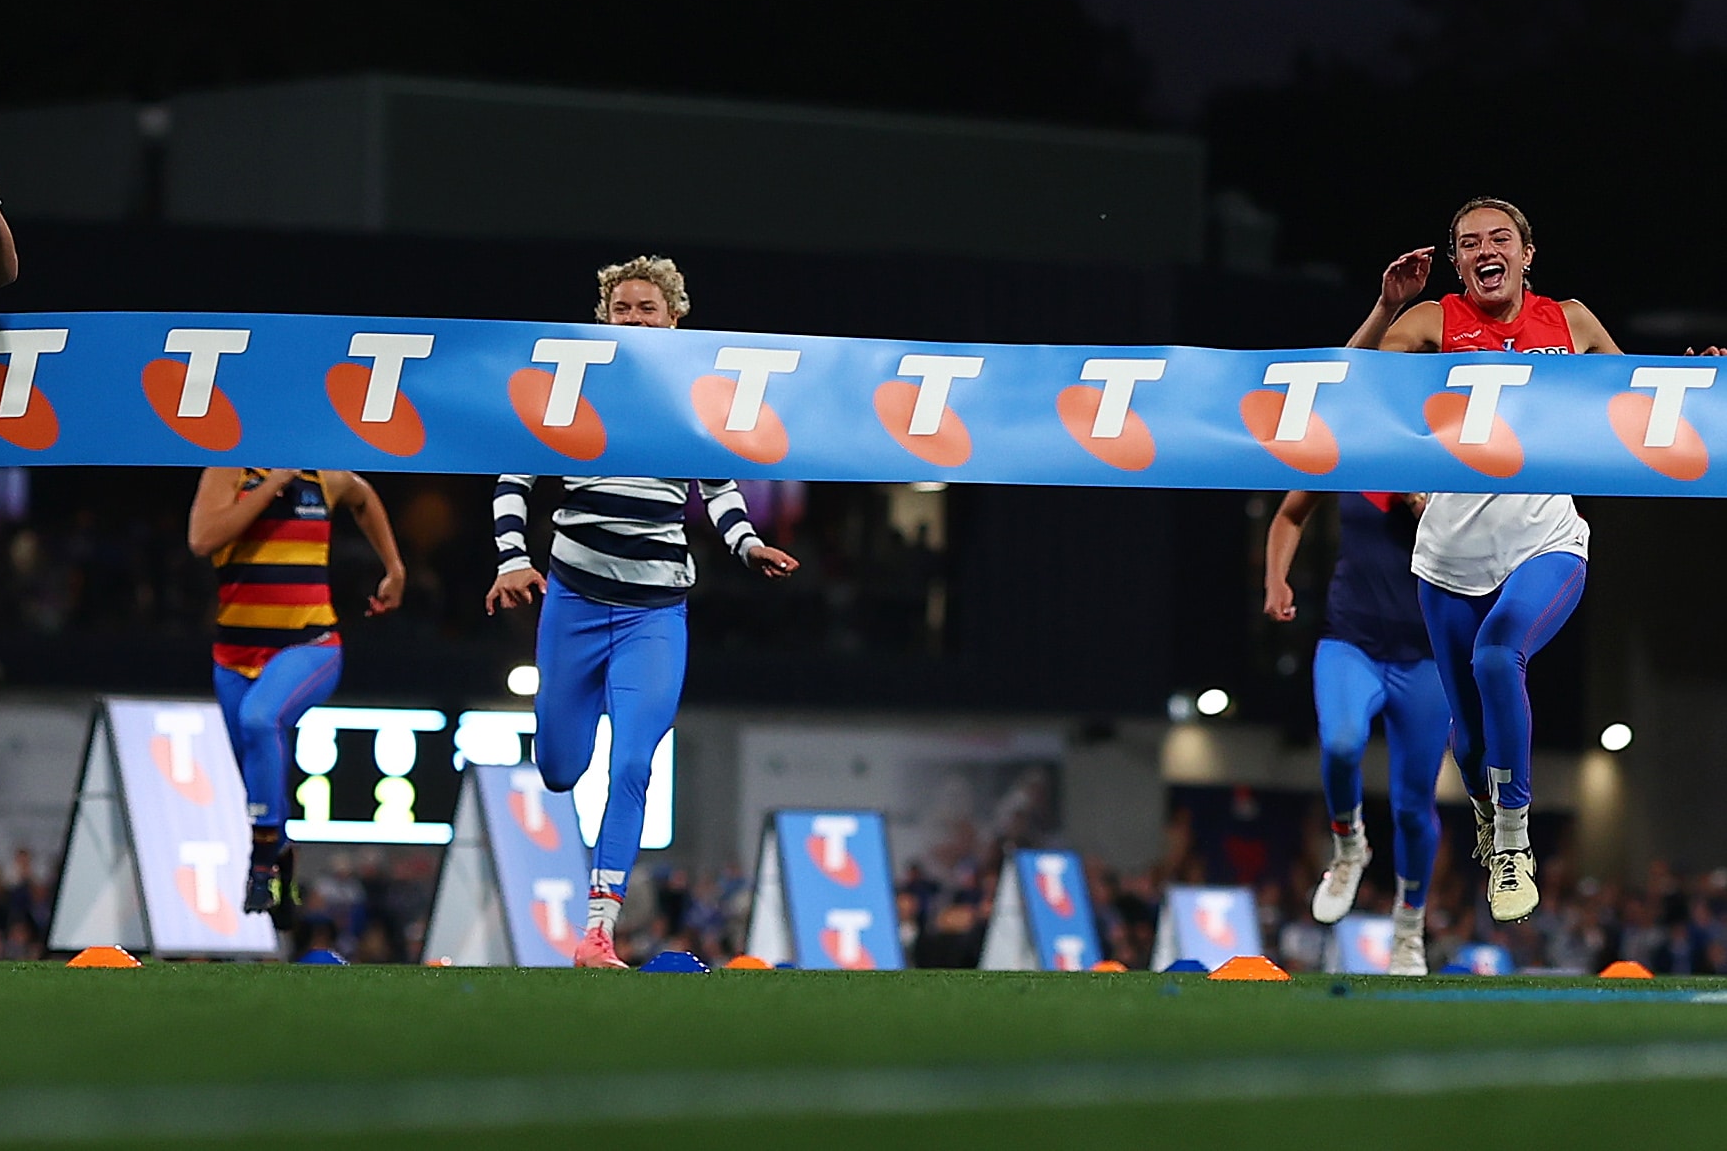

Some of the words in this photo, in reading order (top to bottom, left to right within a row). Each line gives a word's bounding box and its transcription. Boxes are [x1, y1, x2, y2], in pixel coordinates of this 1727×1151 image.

[165, 329, 250, 417] T
[349, 333, 434, 422] T
[532, 339, 618, 426] T
[714, 347, 801, 431] T
[897, 355, 984, 436] T
[1080, 359, 1167, 438] T
[1263, 361, 1350, 441] T
[1445, 365, 1533, 444] T
[1629, 367, 1718, 447] T
[153, 711, 205, 784] T
[179, 841, 229, 914] T
[811, 815, 859, 872] T
[533, 878, 575, 941] T
[825, 909, 873, 970] T
